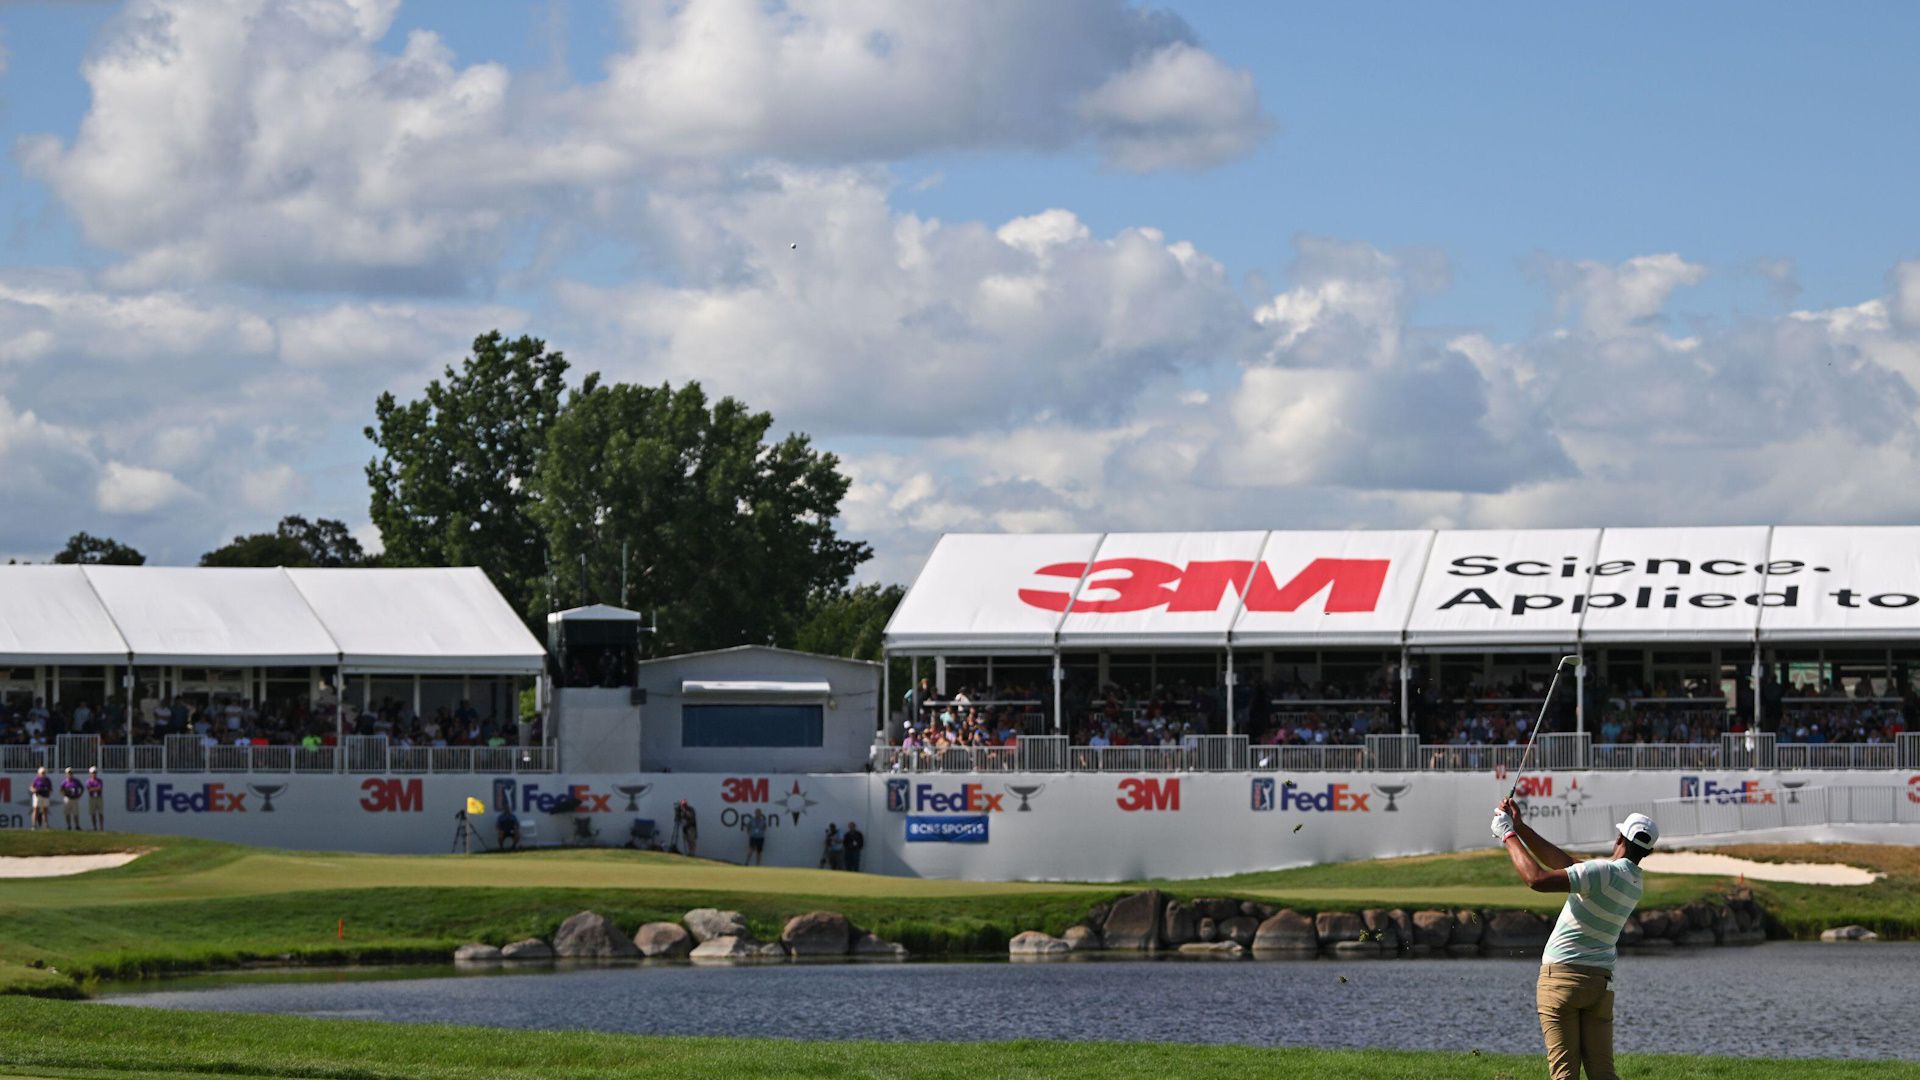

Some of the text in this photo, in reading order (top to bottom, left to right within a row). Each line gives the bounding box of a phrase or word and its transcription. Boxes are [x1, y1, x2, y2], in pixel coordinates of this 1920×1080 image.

[1447, 556, 1831, 577] Science.
[1018, 557, 1391, 614] 3M
[1437, 585, 1920, 615] Applied to
[156, 784, 246, 813] FedEx
[360, 778, 423, 812] 3M
[721, 778, 769, 803] 3M
[916, 783, 1004, 813] FedEx
[1116, 778, 1180, 812] 3M
[1281, 783, 1370, 812] FedEx
[1516, 776, 1553, 798] 3M
[721, 807, 780, 831] Opn
